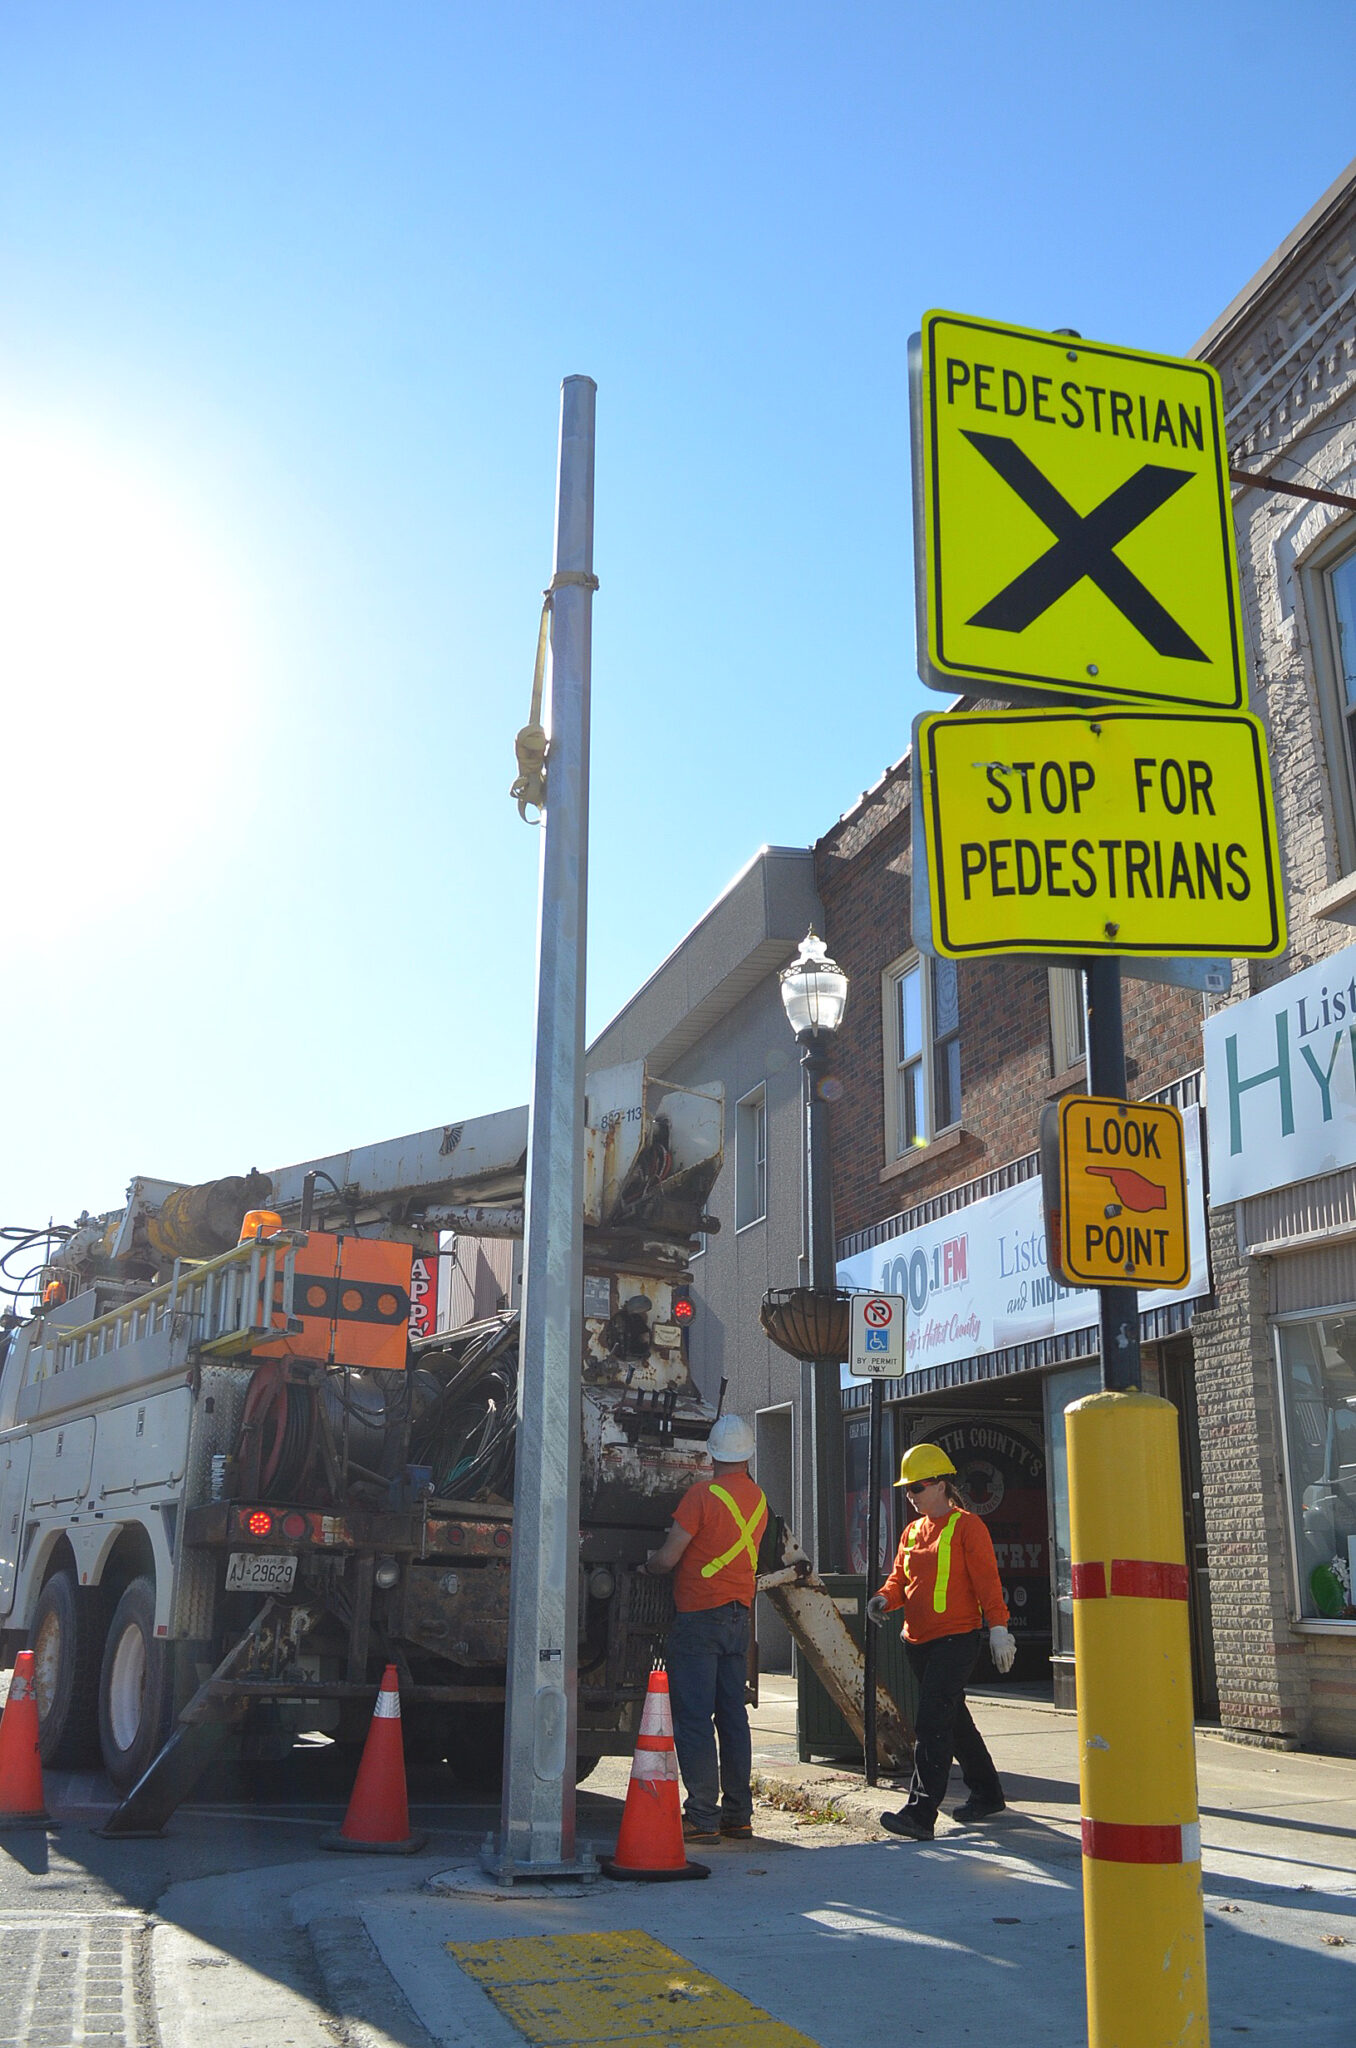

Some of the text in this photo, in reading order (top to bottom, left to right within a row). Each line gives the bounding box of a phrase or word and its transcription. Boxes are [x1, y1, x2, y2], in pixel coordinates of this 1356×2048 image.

[947, 358, 1204, 451] PEDESTRIAN
[986, 758, 1217, 816] STOP FOR
[961, 839, 1251, 902] PEDESTRIANS
[1225, 1009, 1356, 1157] HY
[1085, 1117, 1161, 1158] LOOK
[1085, 1224, 1169, 1267] POINT
[1007, 1281, 1028, 1314] and
[970, 1427, 1043, 1477] COUNTY'S
